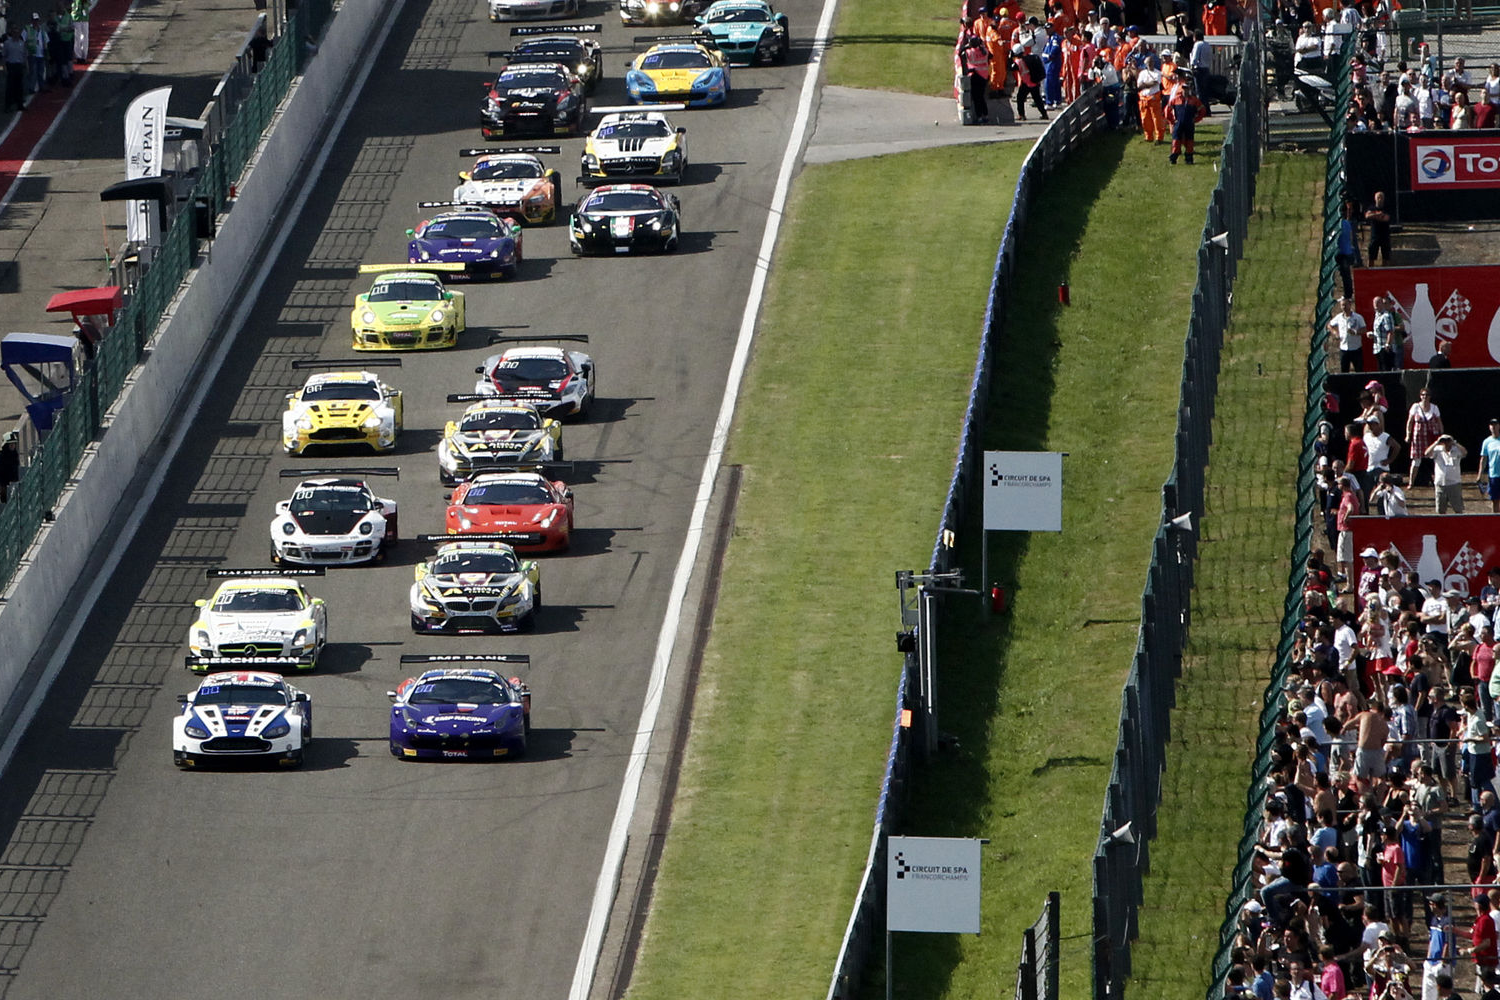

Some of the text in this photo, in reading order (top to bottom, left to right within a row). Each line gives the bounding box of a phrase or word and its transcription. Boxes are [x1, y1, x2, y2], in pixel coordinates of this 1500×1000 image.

[1459, 152, 1500, 173] TO
[199, 656, 300, 664] BEECHDEAN
[954, 866, 968, 874] SPA
